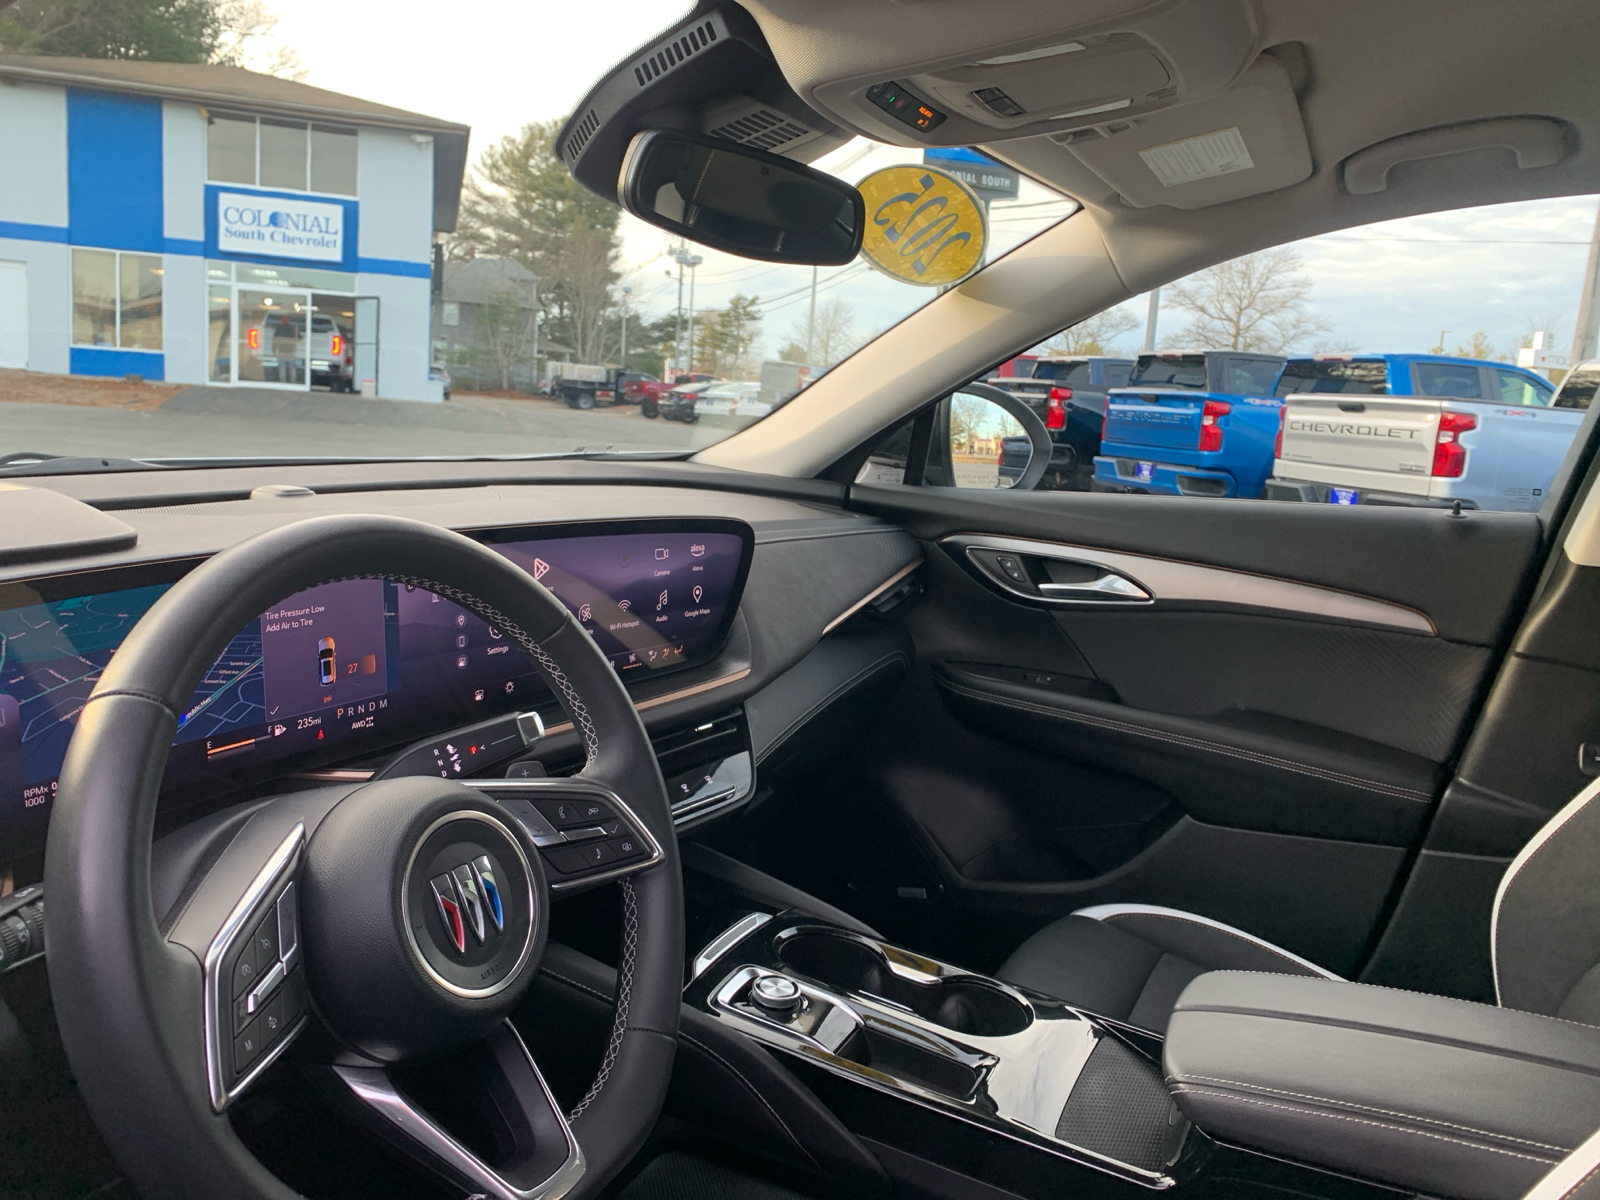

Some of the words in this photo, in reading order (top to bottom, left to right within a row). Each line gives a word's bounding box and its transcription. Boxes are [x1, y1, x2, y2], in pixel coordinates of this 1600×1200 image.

[981, 174, 1011, 188] SOUTH
[223, 206, 339, 235] COLONIAL
[224, 226, 265, 241] South
[270, 230, 338, 249] Chevrolet
[1109, 410, 1193, 425] CHEVROLET
[1290, 421, 1421, 439] CHEVROLET
[690, 544, 706, 552] alexa
[265, 611, 279, 621] Tire
[280, 607, 310, 618] Pressure
[311, 605, 325, 614] Low
[655, 614, 669, 622] Audio
[684, 609, 699, 618] Google
[699, 608, 711, 616] Maps
[265, 621, 280, 633] Add
[281, 620, 291, 630] Air
[291, 620, 299, 629] to
[299, 618, 314, 628] Tire
[609, 622, 621, 631] Wi-Fi
[621, 620, 639, 629] Hotspot
[487, 644, 509, 655] Settings
[347, 663, 358, 674] 27
[323, 694, 333, 704] psi
[337, 708, 344, 719] P
[347, 706, 354, 716] R
[357, 704, 365, 714] N
[369, 702, 376, 712] D
[379, 699, 388, 709] M
[297, 717, 322, 730] 235mi
[351, 720, 366, 730] AWD
[267, 726, 273, 734] F
[206, 740, 212, 749] E
[51, 781, 58, 790] 0
[25, 795, 45, 808] 1000
